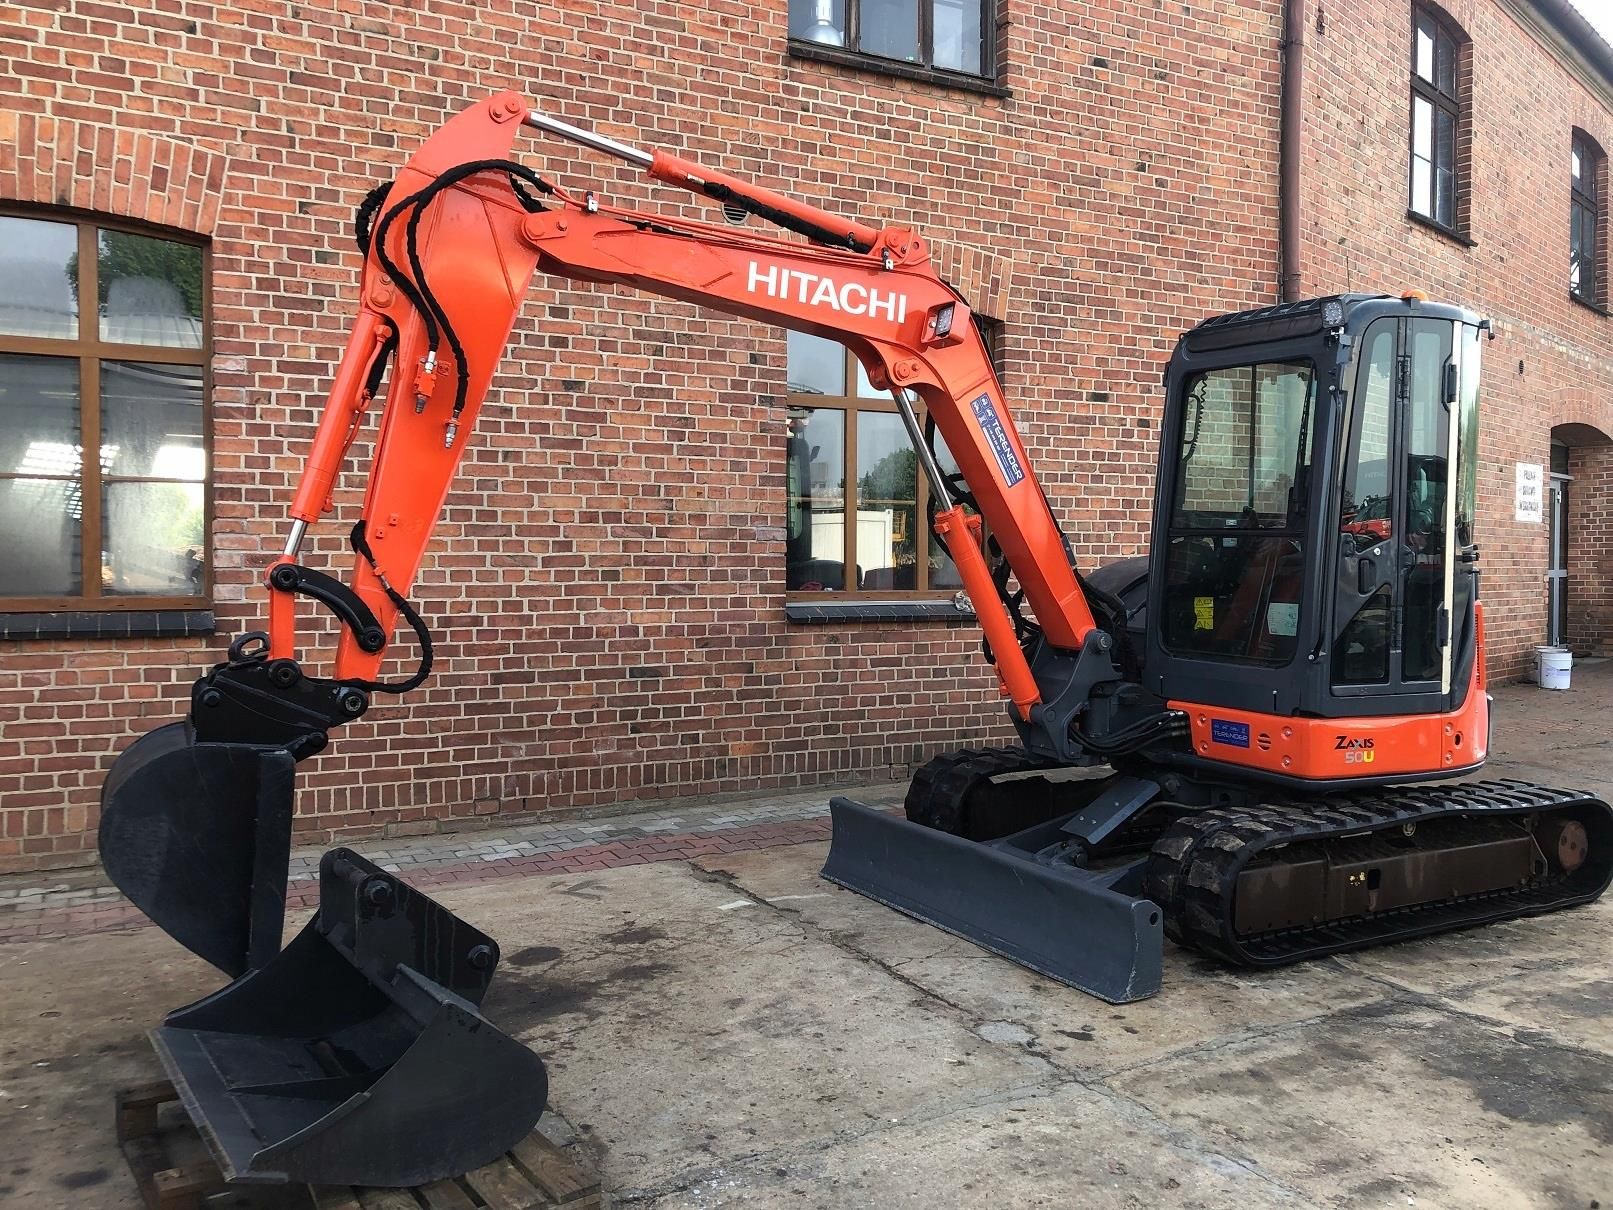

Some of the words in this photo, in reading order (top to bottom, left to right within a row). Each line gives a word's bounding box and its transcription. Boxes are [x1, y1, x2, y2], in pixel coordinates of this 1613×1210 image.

[747, 261, 907, 324] HITACHI
[992, 418, 1023, 480] TERENDER
[1334, 735, 1375, 750] ZAXIS
[1345, 750, 1375, 764] 50U
